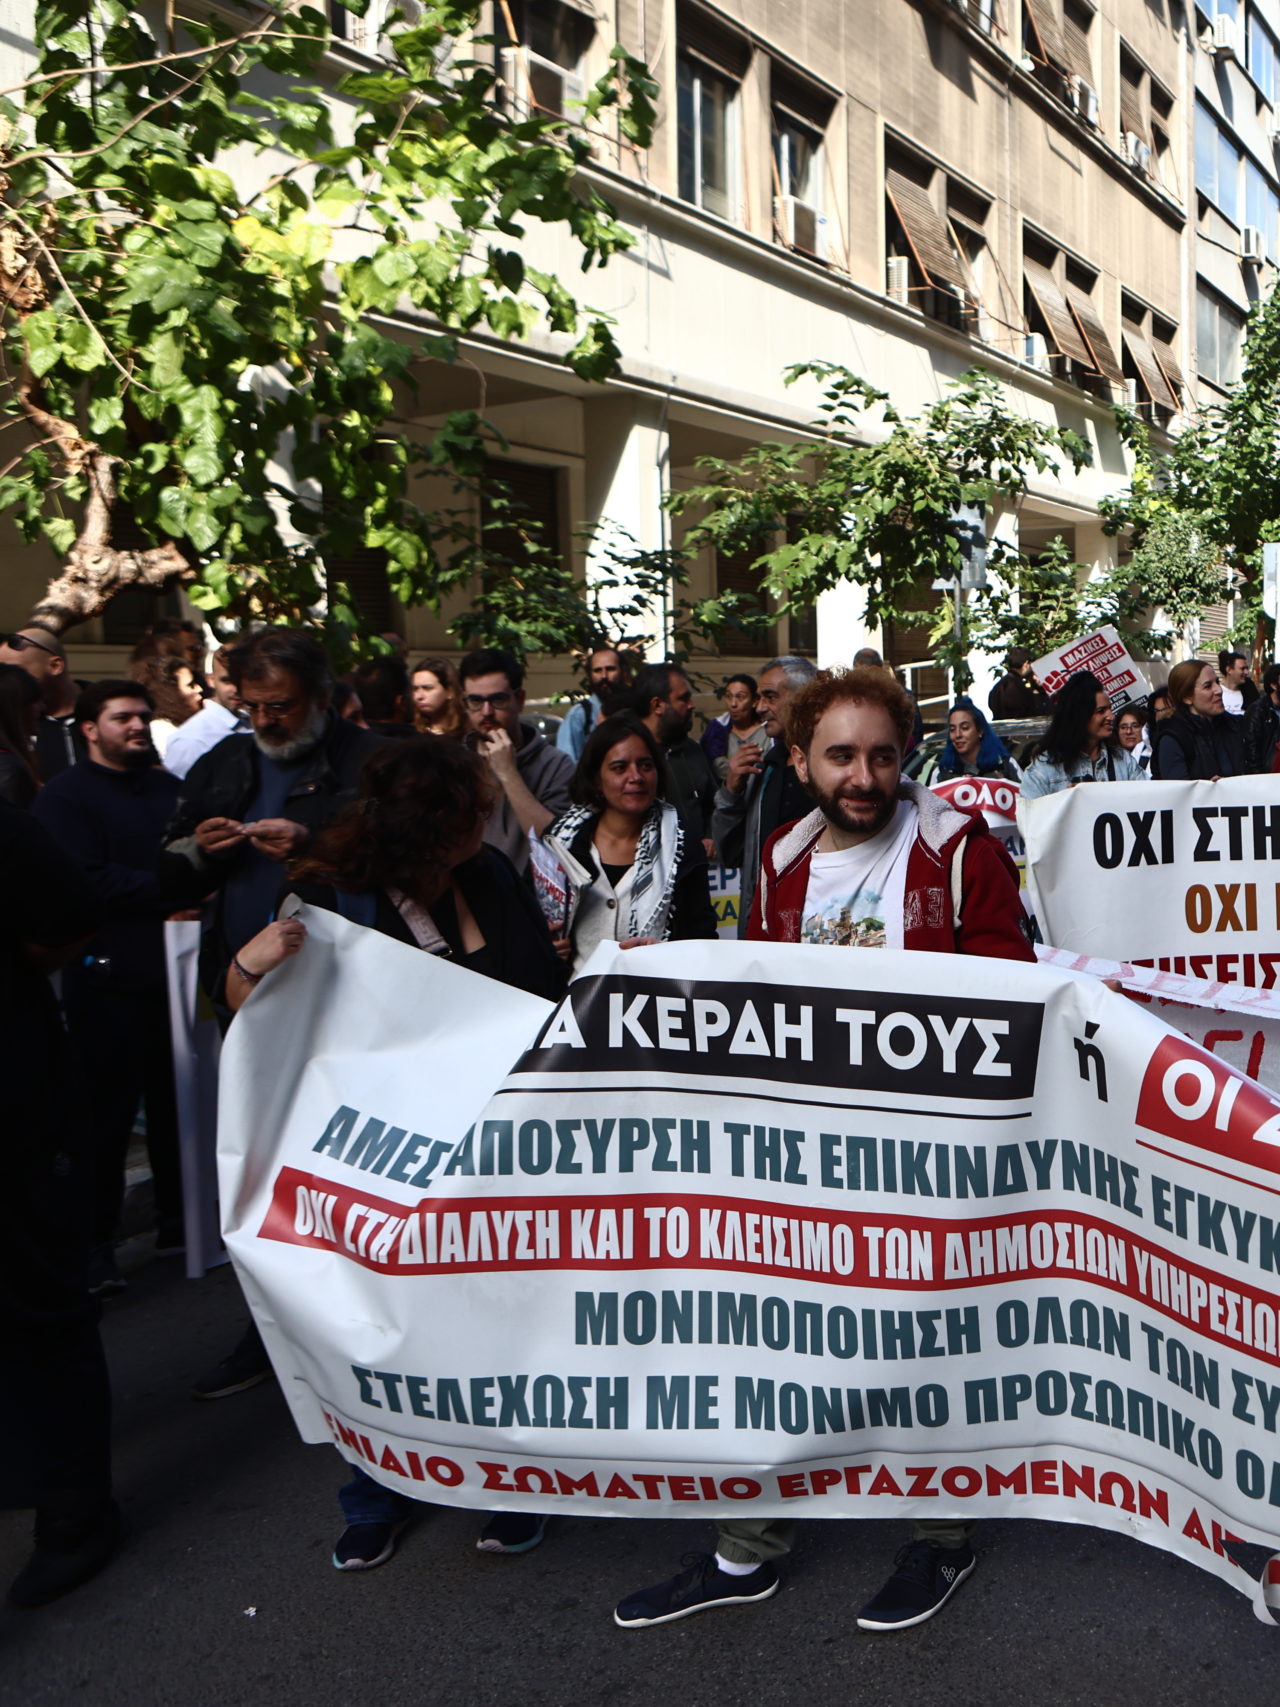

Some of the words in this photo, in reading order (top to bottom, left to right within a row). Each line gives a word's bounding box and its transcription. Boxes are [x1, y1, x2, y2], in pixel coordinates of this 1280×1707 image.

[1064, 637, 1105, 666] ΜΑΖΙΚΕΣ
[1093, 809, 1173, 869] ΟΧΙ
[1185, 884, 1258, 934] ΟΧΙ
[526, 994, 587, 1051] Α
[608, 993, 813, 1061] ΚΕΡΔΗ
[836, 1007, 1012, 1077] ΤΟΥΣ
[1074, 1021, 1108, 1103] ή
[1162, 1058, 1244, 1131] ΟΙ
[312, 1105, 455, 1189] ΑΜΕΣ
[443, 1117, 711, 1177] ΑΠΟΣΥΡΣΗ
[723, 1122, 807, 1185] ΤΗΣ
[820, 1135, 1143, 1217] ΕΠΙΚΙΝΔΥΝΗΣ
[294, 1186, 338, 1243] ΟΧΙ
[398, 1209, 560, 1264] ΔΙΑΛΥΣΗ
[571, 1207, 633, 1260] ΚΑΙ
[645, 1206, 690, 1259] ΤΟ
[700, 1209, 856, 1274] ΚΛΕΙΣΙΜΟ
[862, 1227, 934, 1281] ΤΩΝ
[944, 1221, 1128, 1286] ΔΗΜΟΣΙΩΝ
[575, 1290, 981, 1361] ΜΟΝΙΜΟΠΟΙΗΣΗ
[996, 1297, 1131, 1361] ΟΛΩΝ
[1141, 1322, 1220, 1410] ΤΩΝ
[352, 1365, 629, 1430] ΣΤΕΛΕΧΩΣΗ
[646, 1375, 719, 1430] ΜΕ
[735, 1377, 949, 1435] ΜΟΝΙΜΟ
[964, 1370, 1223, 1480] ΠΡΟΣΩΠΙΚΟ
[476, 1461, 761, 1501] ΣΩΜΑΤΕΙΟ
[777, 1460, 1170, 1527] ΕΡΓΑΖΟΜΕΝΩΝ
